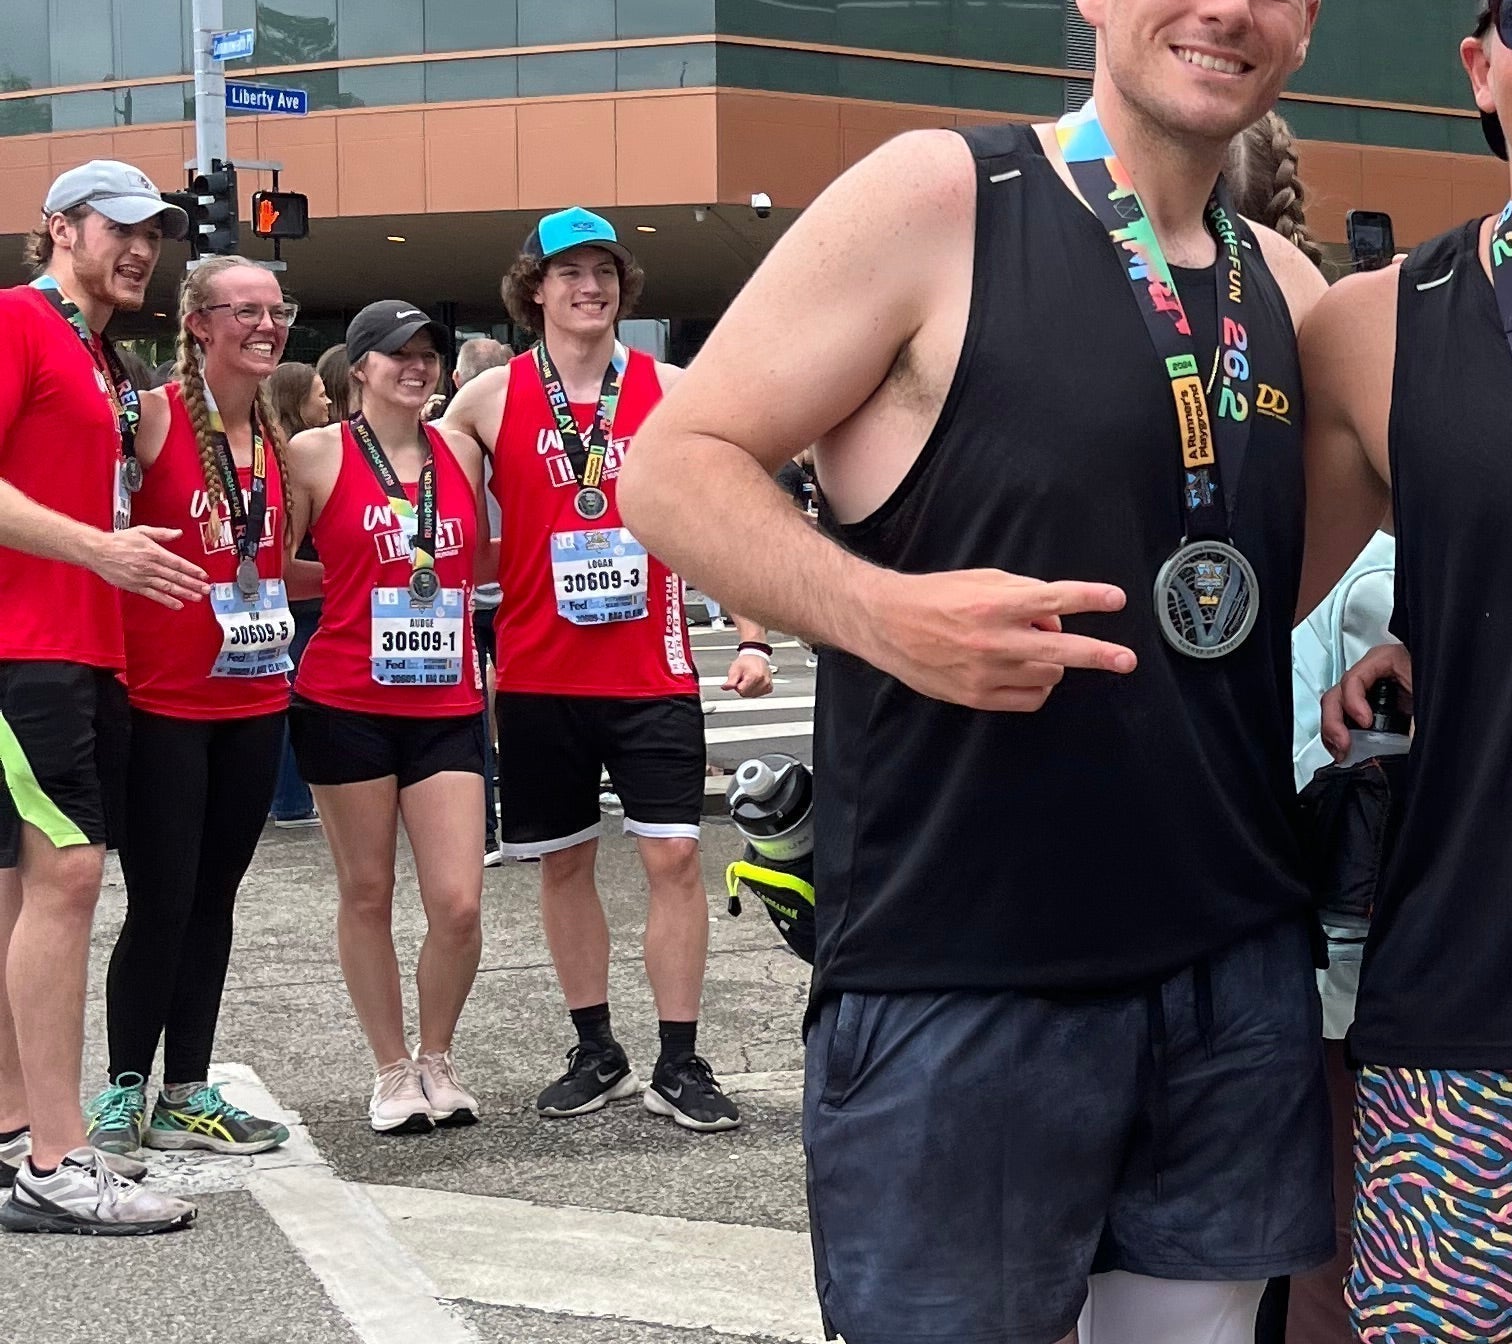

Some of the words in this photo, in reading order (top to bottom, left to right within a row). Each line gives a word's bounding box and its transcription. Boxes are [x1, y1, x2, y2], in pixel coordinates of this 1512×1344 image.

[231, 87, 274, 111] Liberty
[277, 92, 299, 109] Ave
[1218, 315, 1250, 423] 26.2
[545, 380, 577, 436] RELAY
[1189, 449, 1199, 460] A
[563, 568, 640, 593] 30609-3
[382, 631, 456, 652] 30609-1
